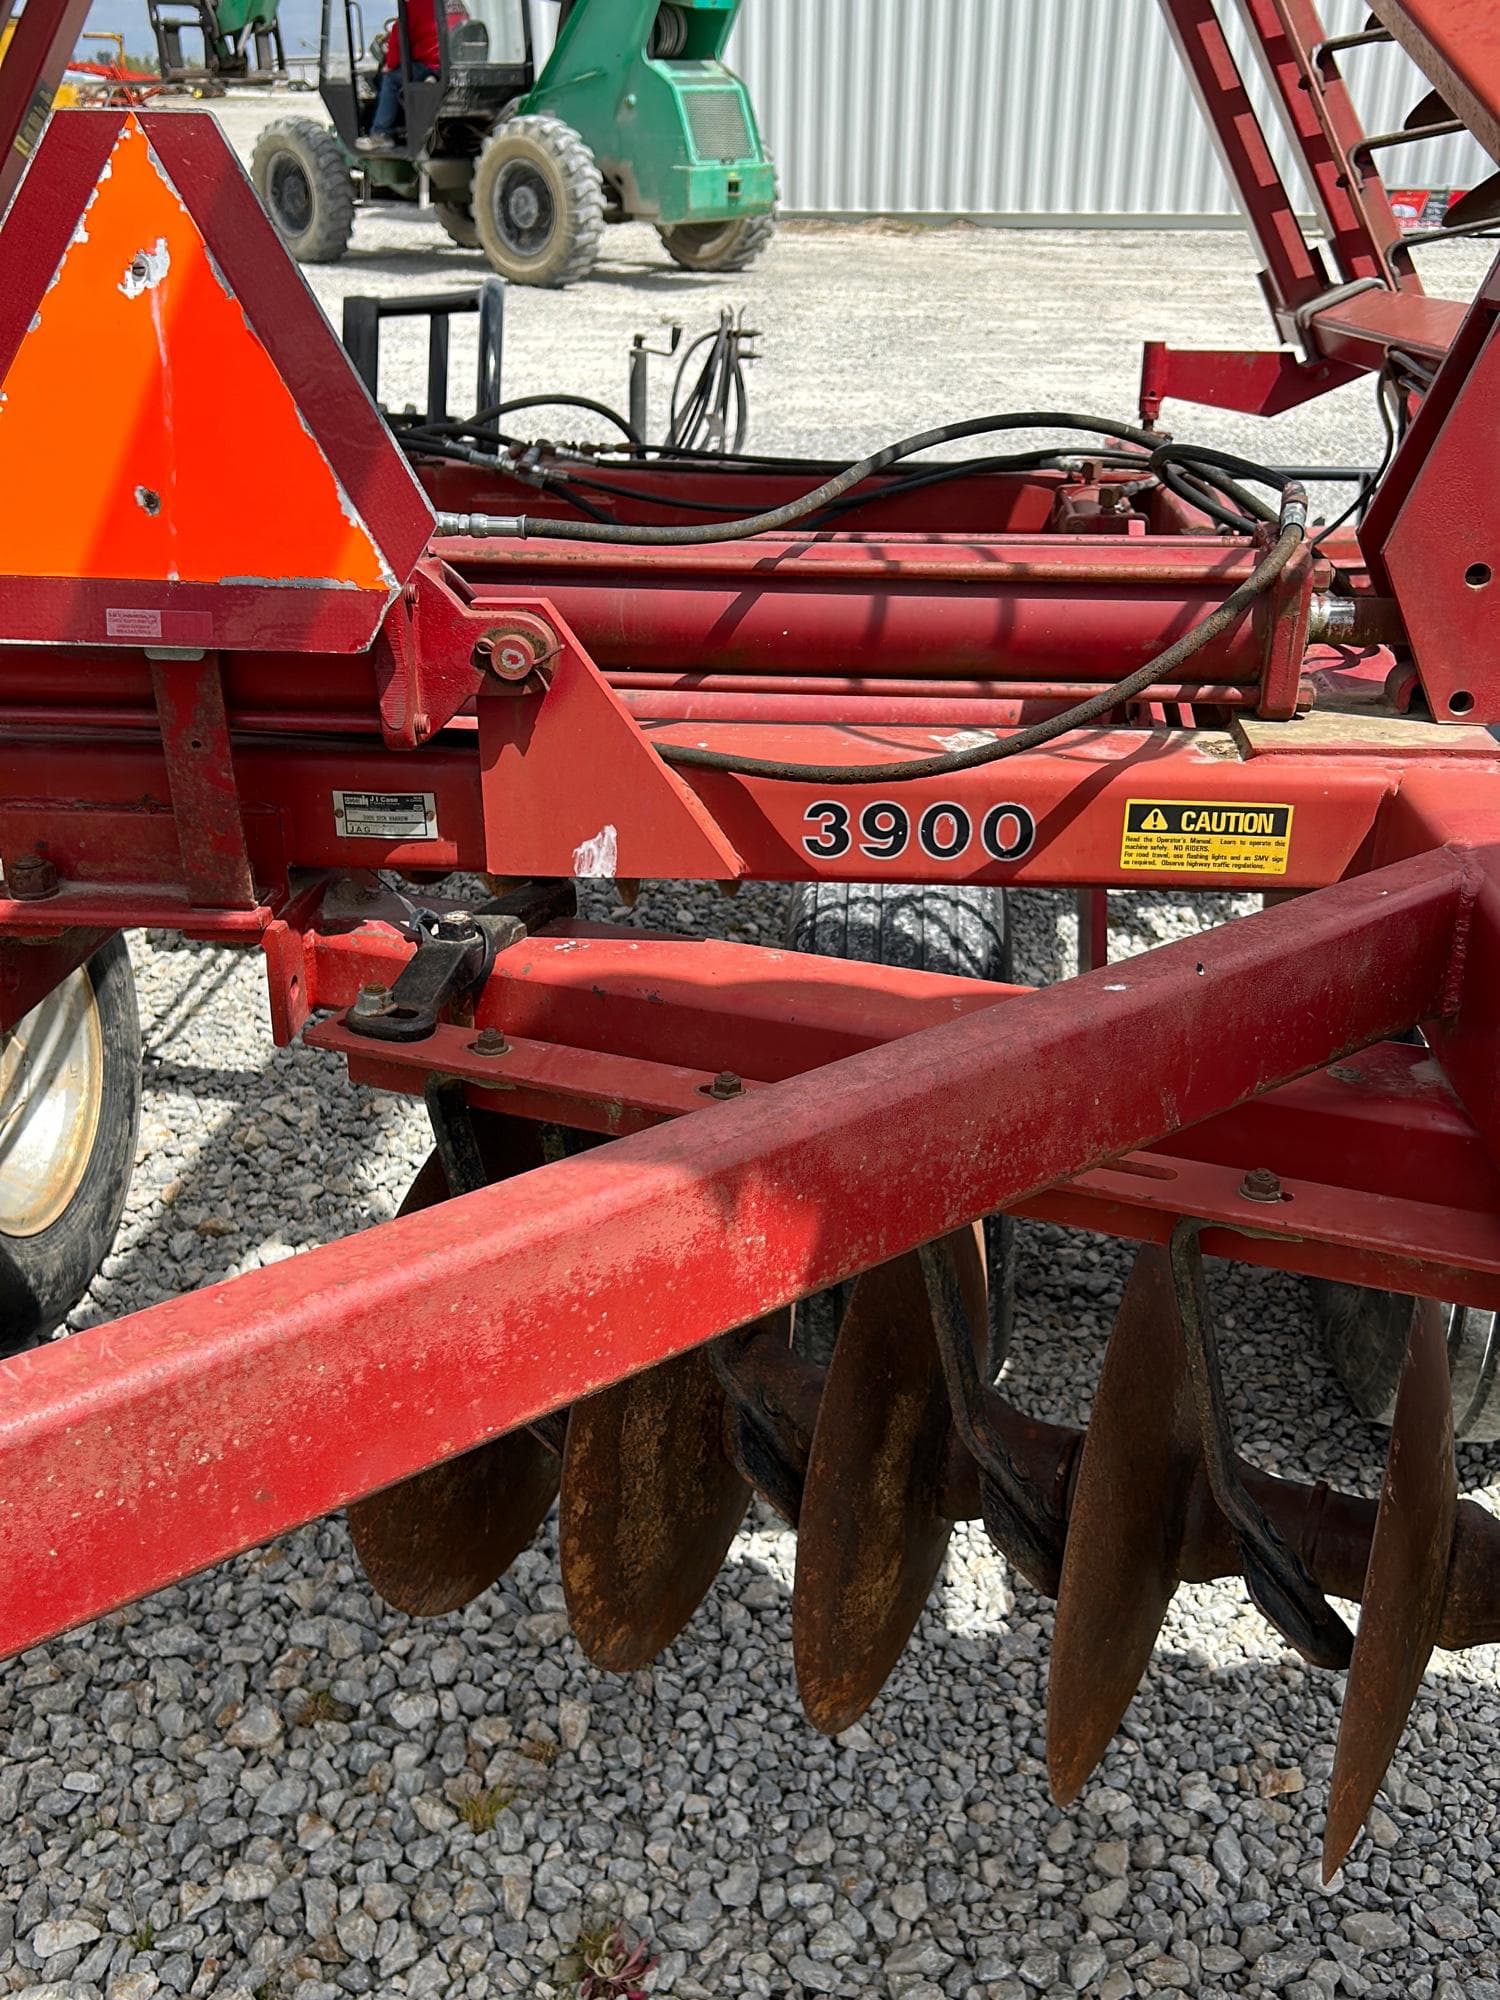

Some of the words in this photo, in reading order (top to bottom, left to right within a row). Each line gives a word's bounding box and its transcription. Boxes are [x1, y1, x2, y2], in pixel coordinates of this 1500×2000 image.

[1181, 811, 1275, 834] CAUTION
[802, 800, 1036, 862] 3900
[1185, 845, 1210, 853] RIDERS.
[1186, 861, 1211, 869] highway
